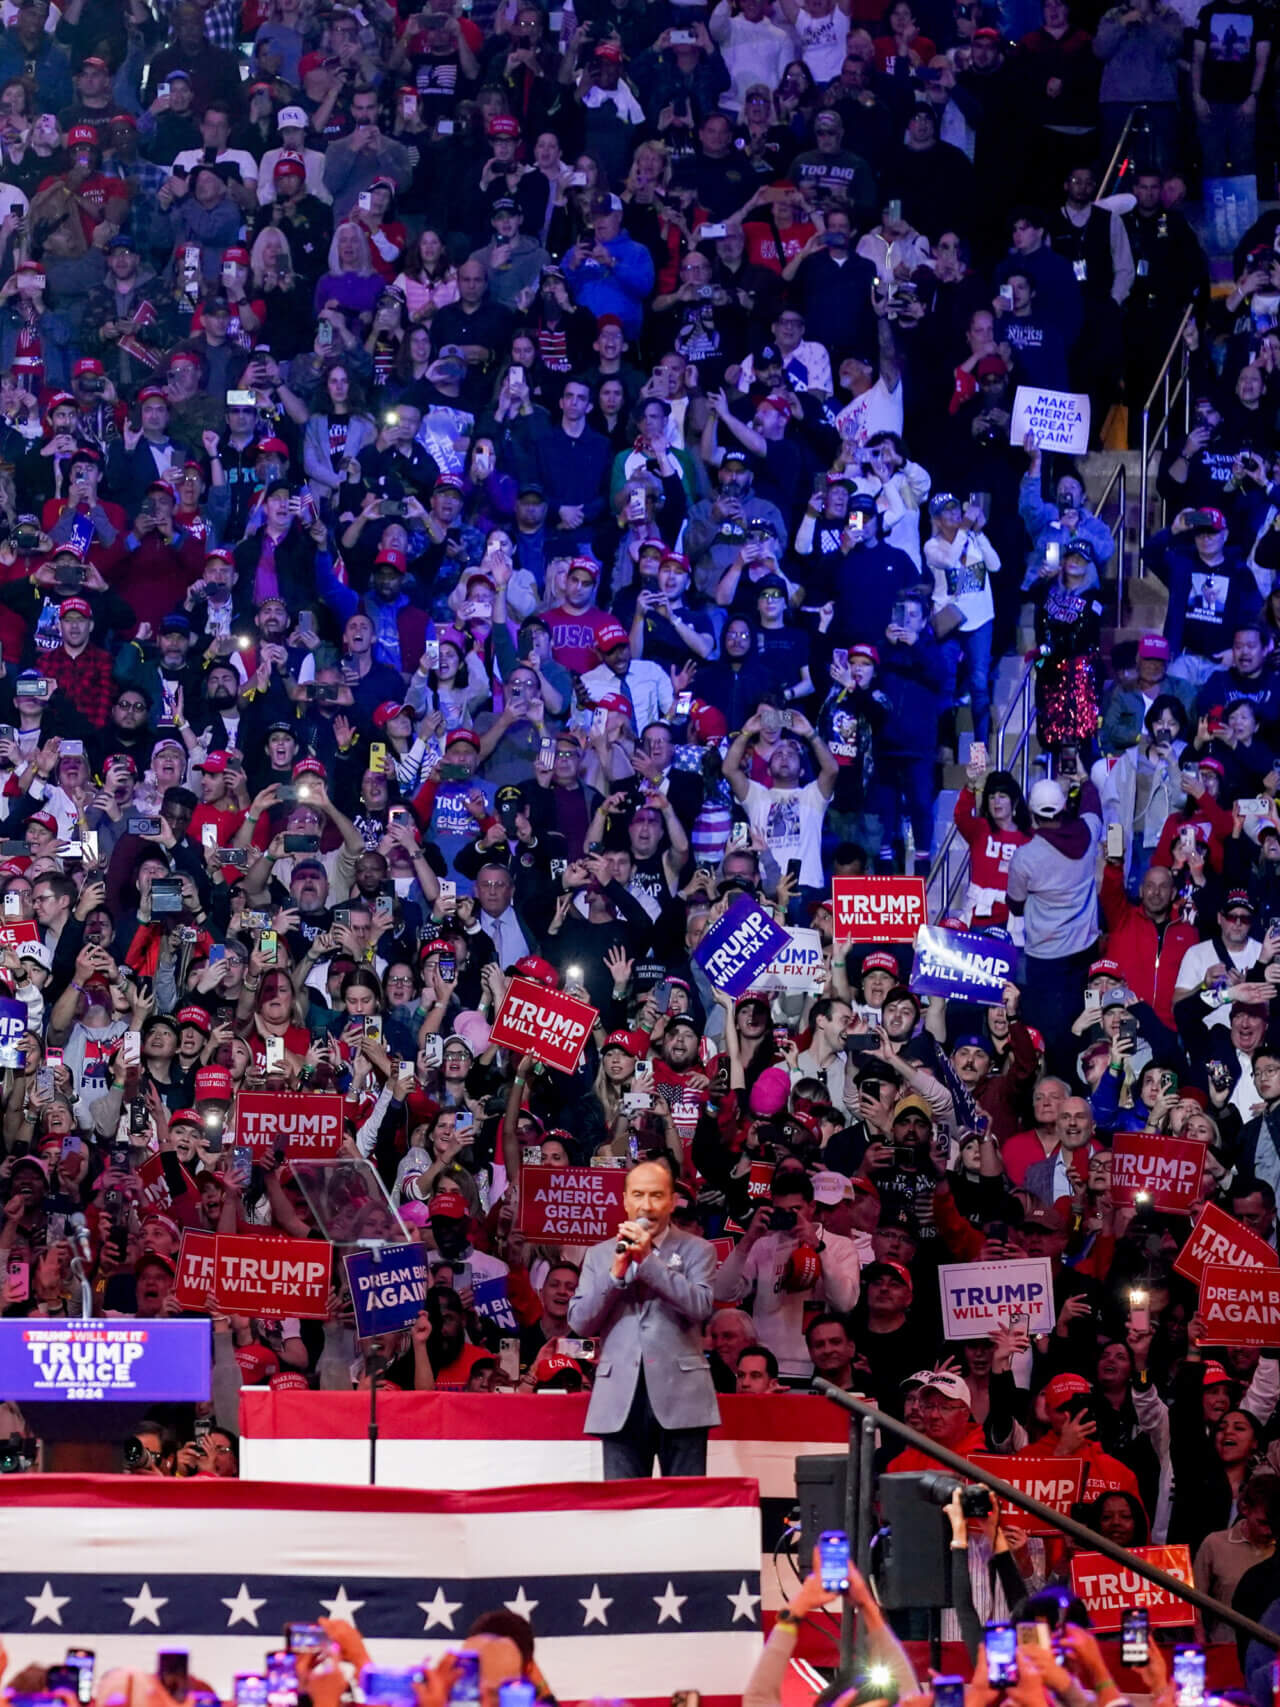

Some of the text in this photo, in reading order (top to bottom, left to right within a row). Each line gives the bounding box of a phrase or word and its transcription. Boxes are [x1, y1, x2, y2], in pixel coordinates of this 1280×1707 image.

[282, 112, 298, 120] USA
[75, 130, 91, 138] USA
[801, 165, 855, 180] TOO BIG
[1037, 395, 1076, 410] MAKE
[1023, 405, 1082, 422] AMERICA
[1029, 416, 1075, 432] GREAT
[424, 434, 451, 474] TRUM
[553, 624, 595, 649] USA
[837, 895, 921, 913] TRUMP
[838, 913, 920, 925] WILL FIX IT
[22, 944, 42, 957] USA
[428, 943, 449, 952] USA
[704, 911, 763, 977] TRUMP
[714, 923, 774, 987] WILL FIX IT
[776, 949, 819, 964] UMP
[921, 947, 1010, 977] TRUMP
[784, 965, 819, 976] FIX IT
[919, 963, 1008, 989] WILL FIX IT
[950, 992, 968, 1000] 2024
[509, 996, 585, 1040] TRUMP
[502, 1014, 578, 1053] WILL FIX IT
[609, 1034, 629, 1044] USA
[7, 1037, 23, 1052] IT
[242, 1112, 337, 1134] TRUMP
[242, 1132, 336, 1147] WIL FIX IT
[1113, 1153, 1197, 1180] TRUMP
[550, 1175, 603, 1190] MAKE
[1112, 1174, 1194, 1195] WILL FIX IT
[534, 1189, 618, 1206] AMERICA
[544, 1204, 607, 1220] GREAT
[542, 1219, 608, 1236] AGAIN!
[221, 1255, 325, 1282] TRUMP
[221, 1277, 324, 1297] WILL FIX IT
[358, 1267, 412, 1291] DREAM
[950, 1283, 1043, 1307] TRUMP
[1207, 1287, 1264, 1303] DREAM
[953, 1302, 1043, 1320] WILL FIX IT
[28, 1331, 142, 1342] TRUMP WILL FIX IT
[28, 1342, 144, 1365] TRUMP
[41, 1363, 131, 1381] VANCE
[548, 1359, 574, 1369] USA
[66, 1388, 104, 1400] 2024
[1002, 1479, 1074, 1501] UMP
[1083, 1590, 1163, 1611] WILL FIX
